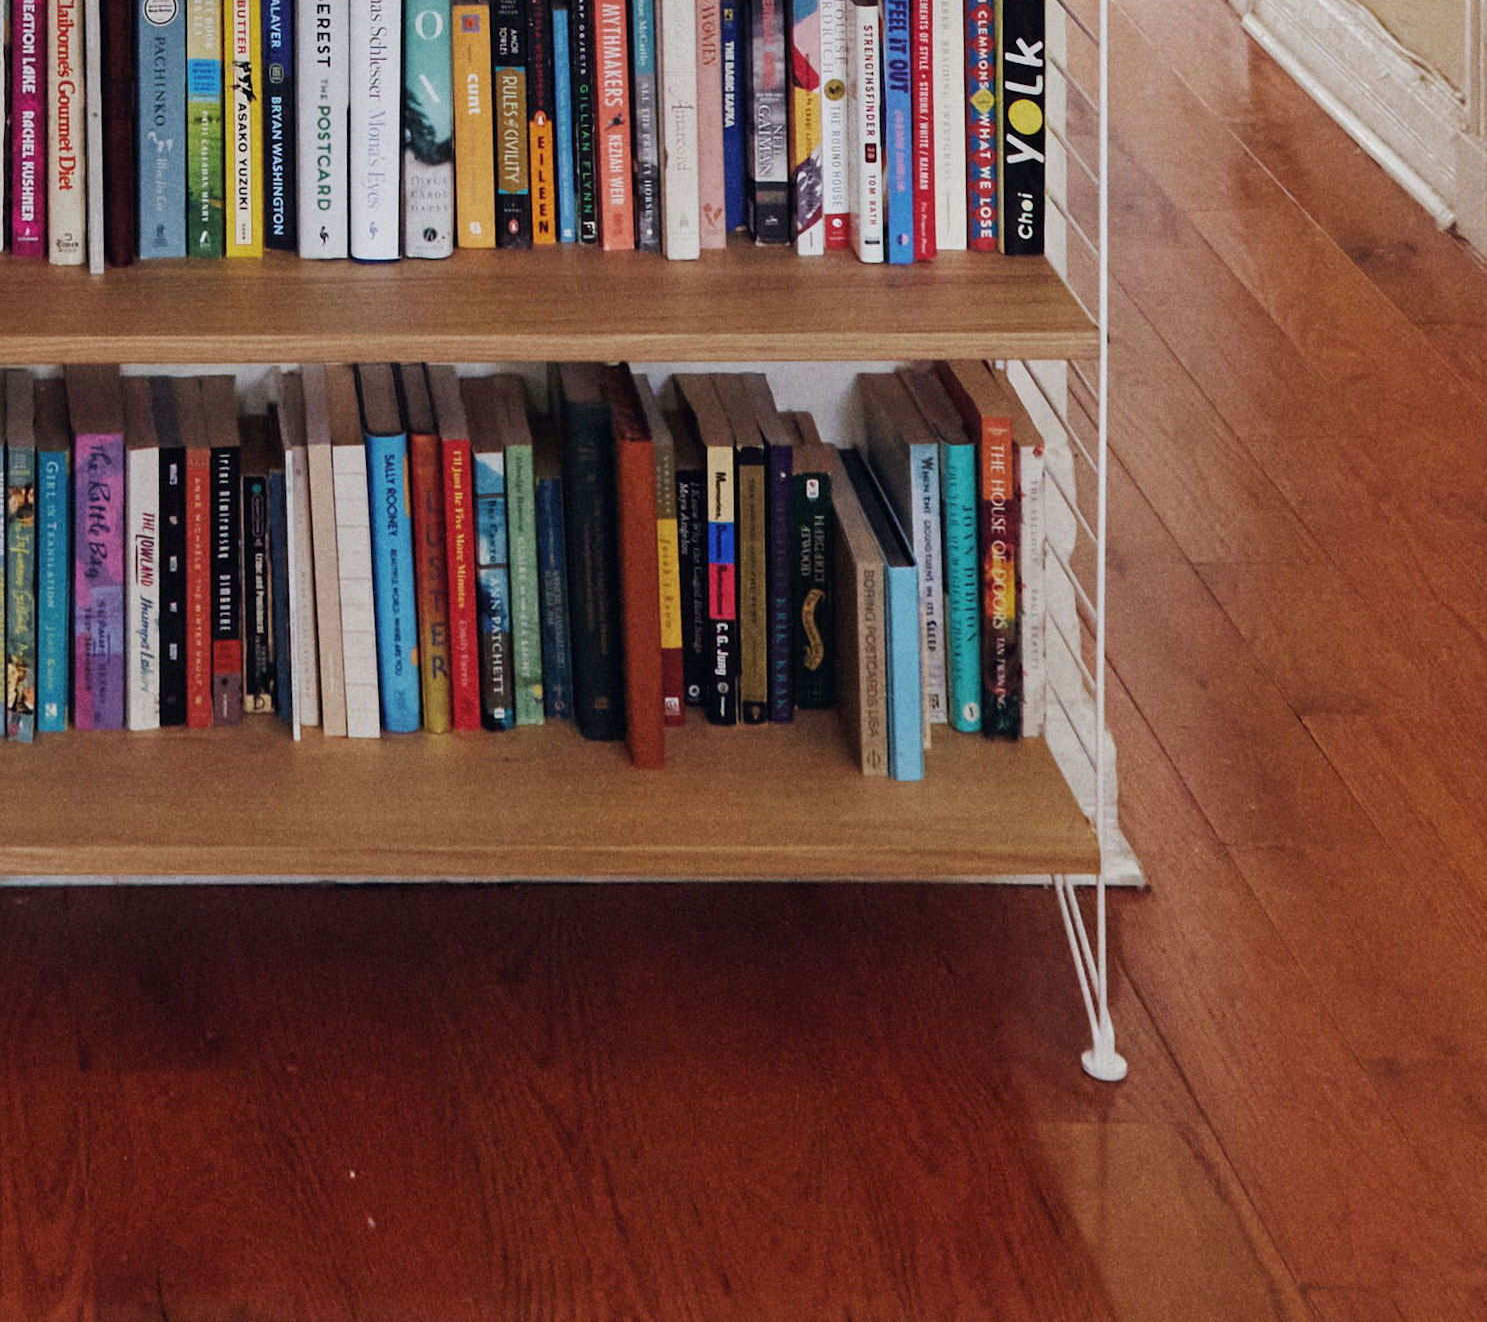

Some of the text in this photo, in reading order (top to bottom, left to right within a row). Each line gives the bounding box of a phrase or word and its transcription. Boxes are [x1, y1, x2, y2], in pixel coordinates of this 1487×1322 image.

[21, 57, 36, 94] LAKE
[153, 36, 166, 127] PACHINKO
[368, 26, 388, 102] Schlesser
[601, 4, 624, 107] MYTHMAKERS
[862, 24, 875, 137] STRENGTHSFINDER
[888, 0, 909, 93] FEEL OUT
[919, 45, 929, 70] STYLE
[977, 10, 989, 90] CLEMMONS
[57, 80, 76, 152] Gourmet
[236, 0, 248, 211] BUTTER ASAKO YUZUKI
[270, 96, 283, 139] BRYAN
[466, 73, 481, 116] cunt
[501, 75, 520, 183] RULES CIVILITY
[724, 93, 735, 128] KAFKA
[22, 110, 36, 158] RACHEL
[317, 105, 331, 212] POSTCARD
[579, 84, 593, 214] GILLIAN FLYNN
[607, 134, 624, 173] KEZIAH
[757, 104, 774, 177] GAIMAN
[830, 105, 844, 208] THE ROUND HOUSE
[977, 113, 991, 159] WHAT
[21, 161, 34, 222] KUSHNER
[58, 155, 77, 191] Diet
[271, 142, 284, 235] WASHINGTON
[609, 177, 625, 205] WEIR
[978, 166, 992, 190] WE
[979, 197, 993, 239] LOSE
[141, 511, 155, 532] THE
[383, 454, 398, 537] SALLY ROONEY
[452, 467, 467, 609] Just Five More Minutes
[961, 504, 977, 643] JOAN DIDION
[989, 444, 1008, 630] THE HOUSE OF DOORS
[255, 590, 265, 634] Punishment
[489, 577, 504, 696] ANN PATCHETT
[714, 649, 729, 676] Jung
[863, 569, 880, 737] BORING POSTCARDS USA
